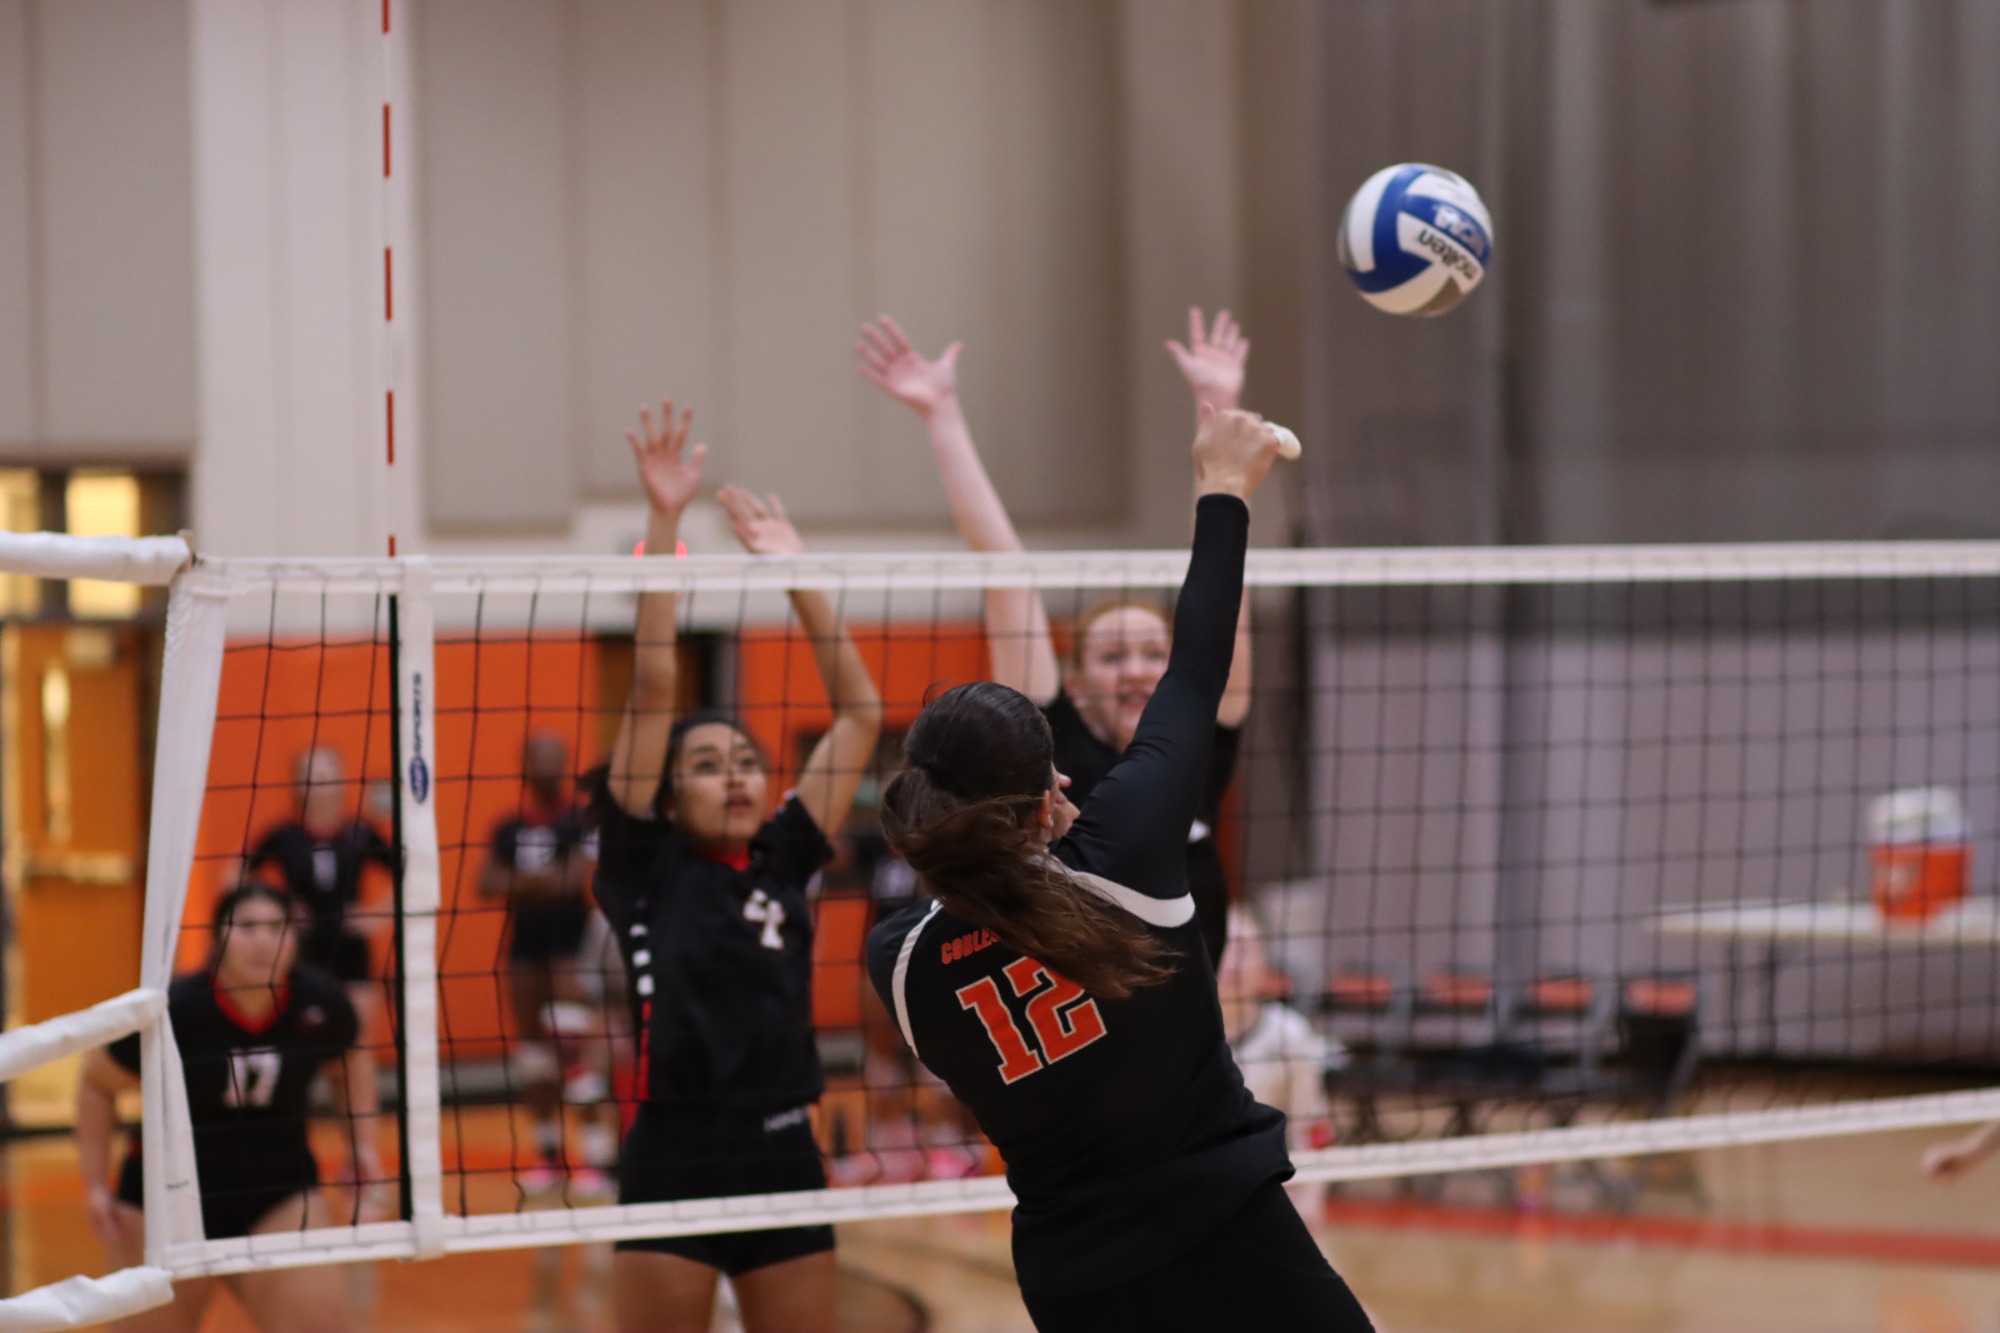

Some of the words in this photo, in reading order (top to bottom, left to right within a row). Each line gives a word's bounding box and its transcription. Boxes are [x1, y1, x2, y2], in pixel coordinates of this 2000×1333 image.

[1418, 228, 1479, 281] molten
[955, 956, 1107, 1086] 12
[224, 1047, 282, 1108] 17
